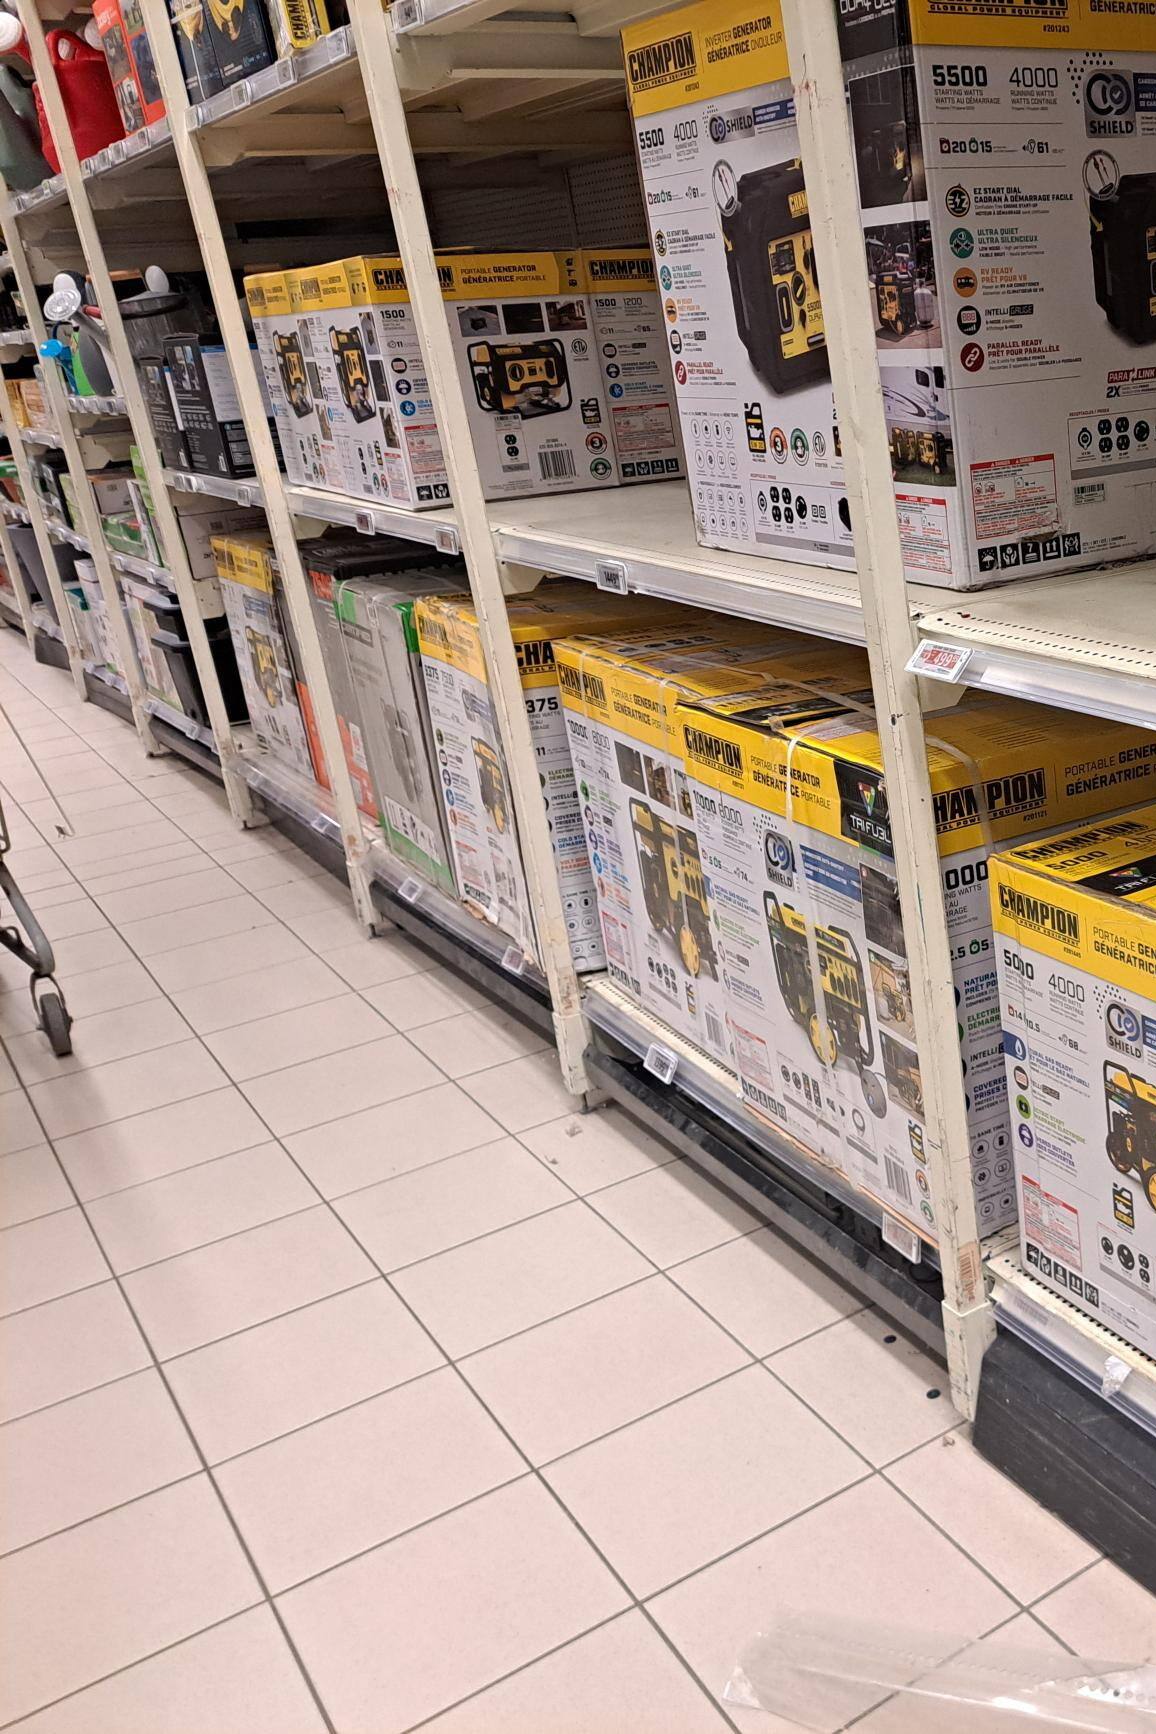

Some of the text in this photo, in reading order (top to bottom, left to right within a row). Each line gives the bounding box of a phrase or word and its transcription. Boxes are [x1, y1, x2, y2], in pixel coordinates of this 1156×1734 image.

[929, 5, 1067, 17] GLOBAL POWER EQUIPMENT
[705, 17, 772, 47] INVERTER GENERATOR
[1042, 25, 1070, 33] #201243
[707, 32, 782, 63] GÉNÉRATRICE ONDULEUR
[628, 34, 694, 83] CHAMPION
[932, 65, 987, 87] 5500
[1009, 67, 1058, 88] 4000
[935, 89, 984, 97] STARTING WATTS
[935, 97, 954, 105] WATTS
[966, 96, 1000, 105] DÉMARRAGE
[673, 120, 698, 142] 4000
[726, 114, 753, 135] SHIELD
[1089, 120, 1134, 134] SHIELD
[638, 128, 664, 149] 5500
[952, 141, 992, 153] 20 15
[1037, 142, 1049, 153] 61
[984, 187, 1004, 195] START
[974, 193, 1073, 204] CADRAN DÉMARRAGE FACILE
[1000, 227, 1018, 236] QUIET
[978, 236, 1038, 244] ULTRA SILENCIEUX
[493, 264, 537, 273] GENERATOR
[991, 267, 1013, 275] READY
[462, 275, 514, 284] GÉNÉRATRICE
[1000, 274, 1017, 282] POUR
[596, 298, 616, 307] 1500
[380, 309, 405, 319] 1500
[987, 339, 1042, 350] PARALLEL READY
[1005, 348, 1023, 356] POUR
[1024, 344, 1060, 355] PARALLÈLE
[1107, 386, 1120, 398] 2X
[685, 726, 743, 770] CHAMPION
[750, 755, 821, 789] PORTABLE GENERATOR
[1064, 756, 1115, 778] PORTABLE
[1066, 764, 1151, 797] GÉNÉRATRICE
[800, 790, 831, 809] PORTABLE
[1023, 810, 1048, 822] #201121
[1019, 821, 1143, 861] CHAMPION
[1047, 850, 1109, 871] 5000
[768, 868, 793, 889] SHIELD
[958, 884, 982, 897] WATTS
[999, 884, 1079, 940] CHAMPION
[1019, 918, 1081, 947] POWER EQUIPMENT
[1092, 926, 1136, 952] PORTABLE
[982, 939, 989, 951] 5
[1048, 973, 1085, 1003] 4000
[1014, 1010, 1023, 1021] 14
[1067, 1038, 1079, 1051] 68
[1108, 1036, 1142, 1060] SHIELD
